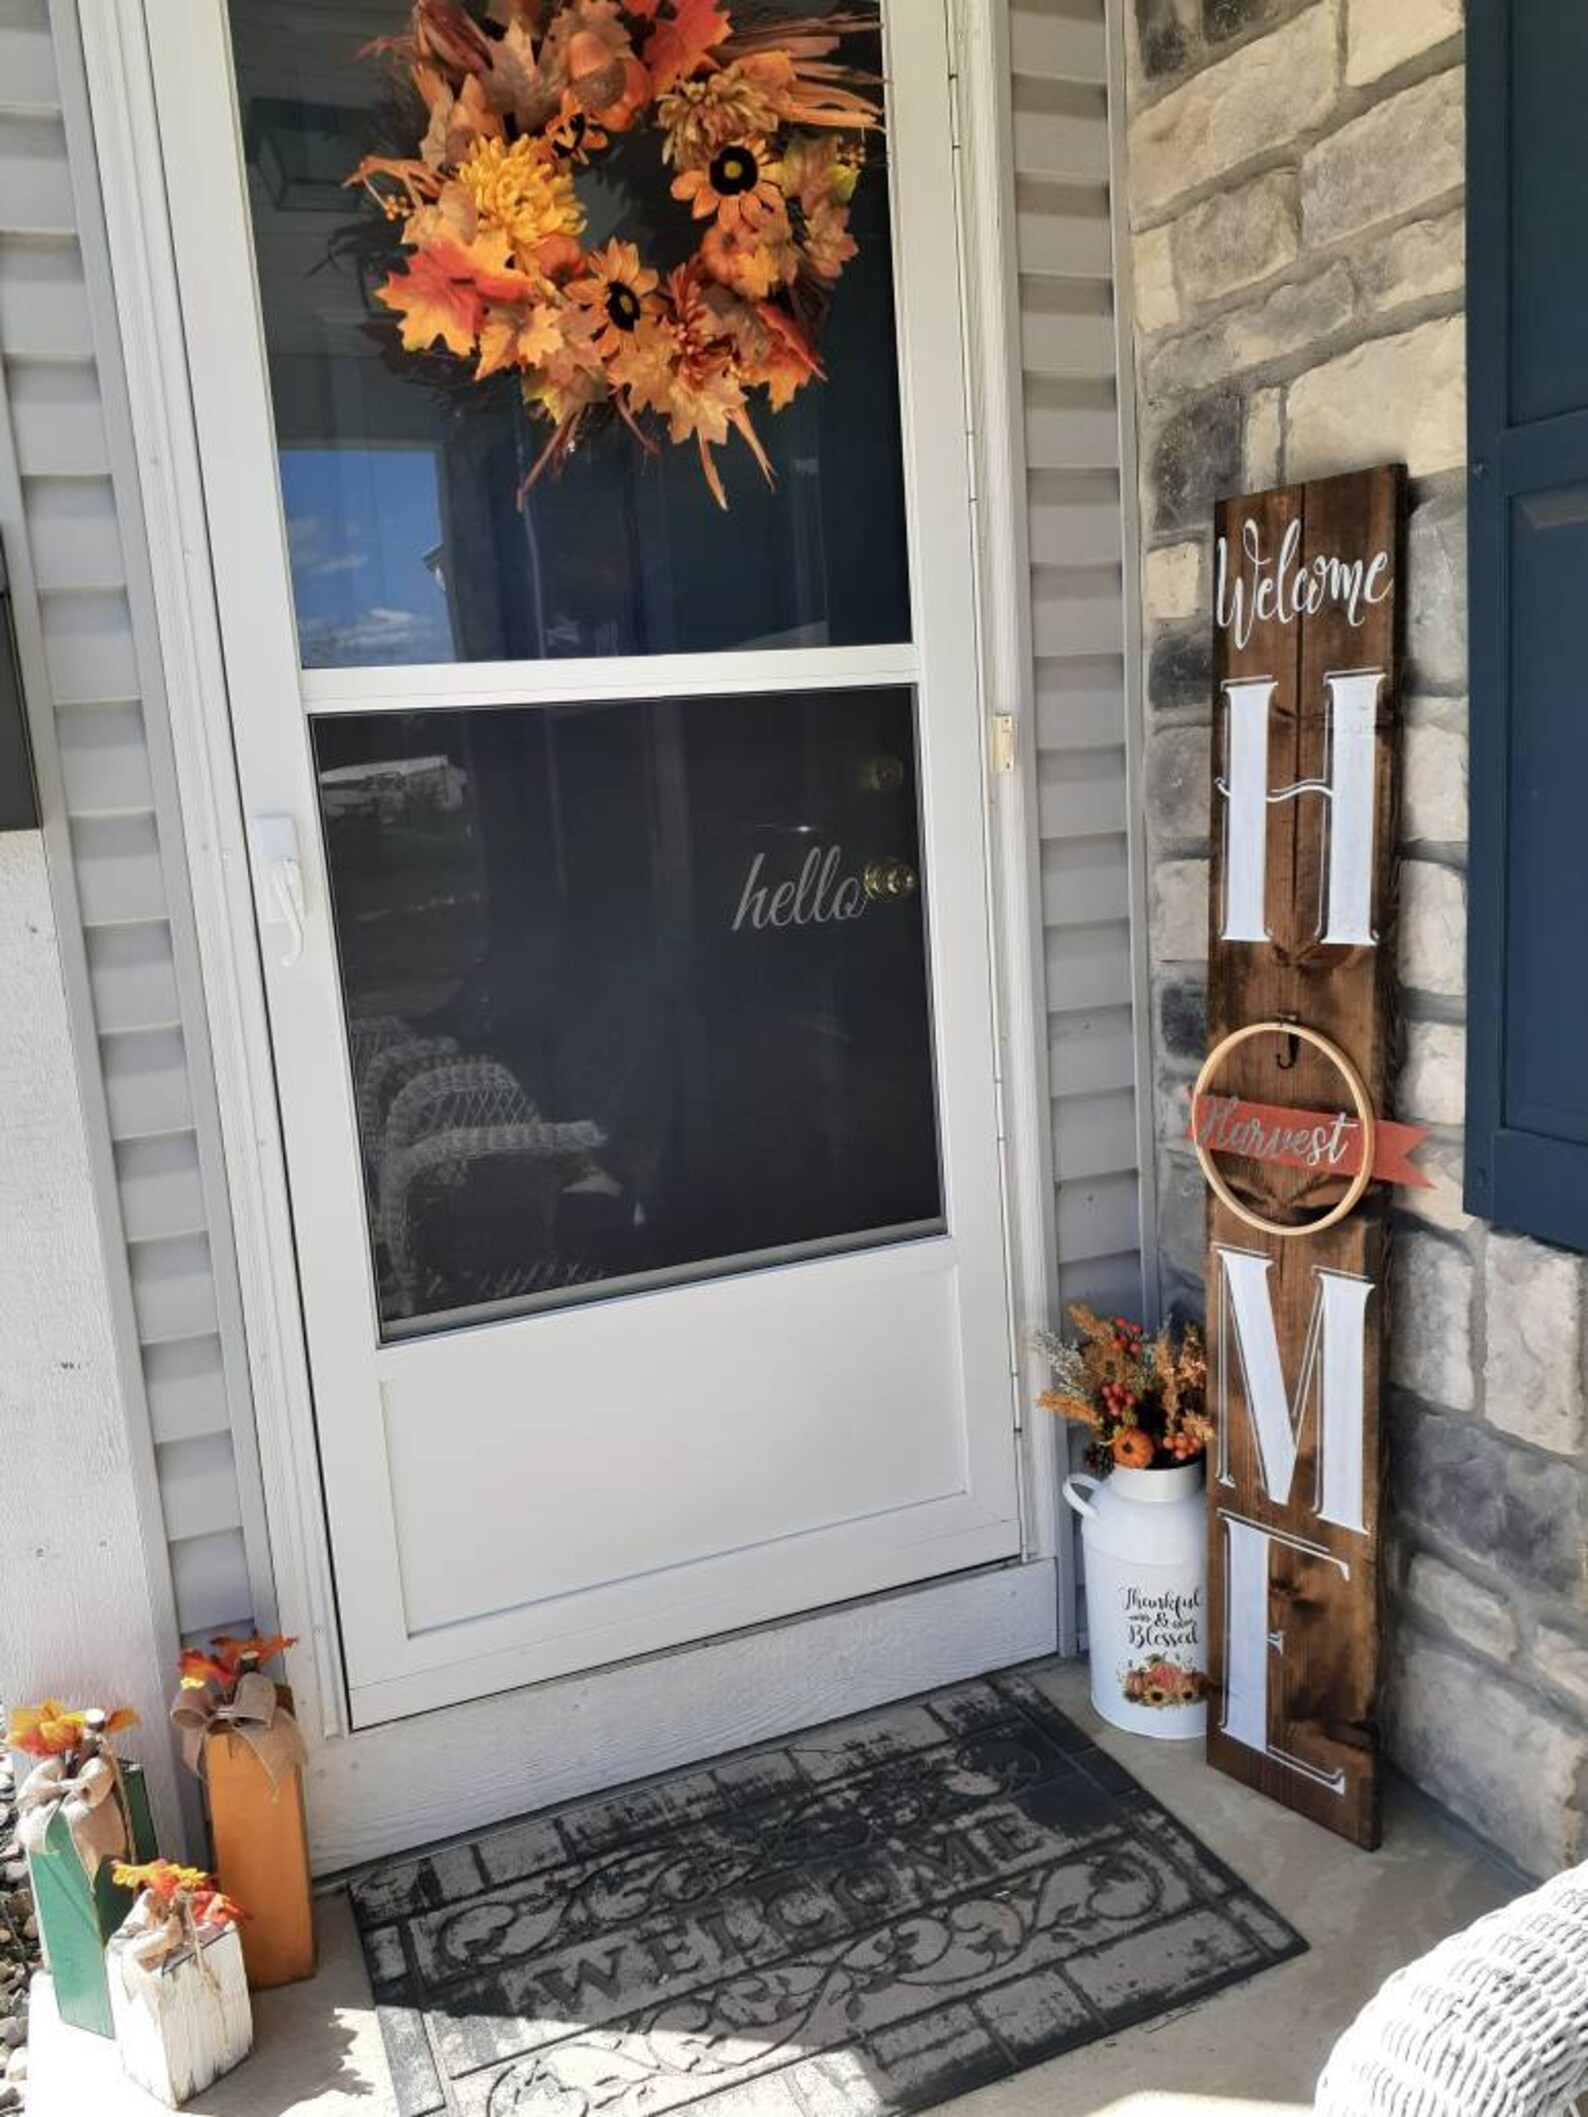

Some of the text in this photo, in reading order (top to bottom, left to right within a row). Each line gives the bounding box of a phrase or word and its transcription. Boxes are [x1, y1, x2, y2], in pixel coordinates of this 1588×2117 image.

[1215, 518, 1393, 650] Welcome
[732, 845, 868, 931] hello
[1200, 1094, 1358, 1167] Harvest
[1120, 1586, 1200, 1620] Thankful
[1128, 1624, 1199, 1649] Blessed
[1154, 1612, 1170, 1629] &
[532, 1810, 1047, 2003] WELCOME
